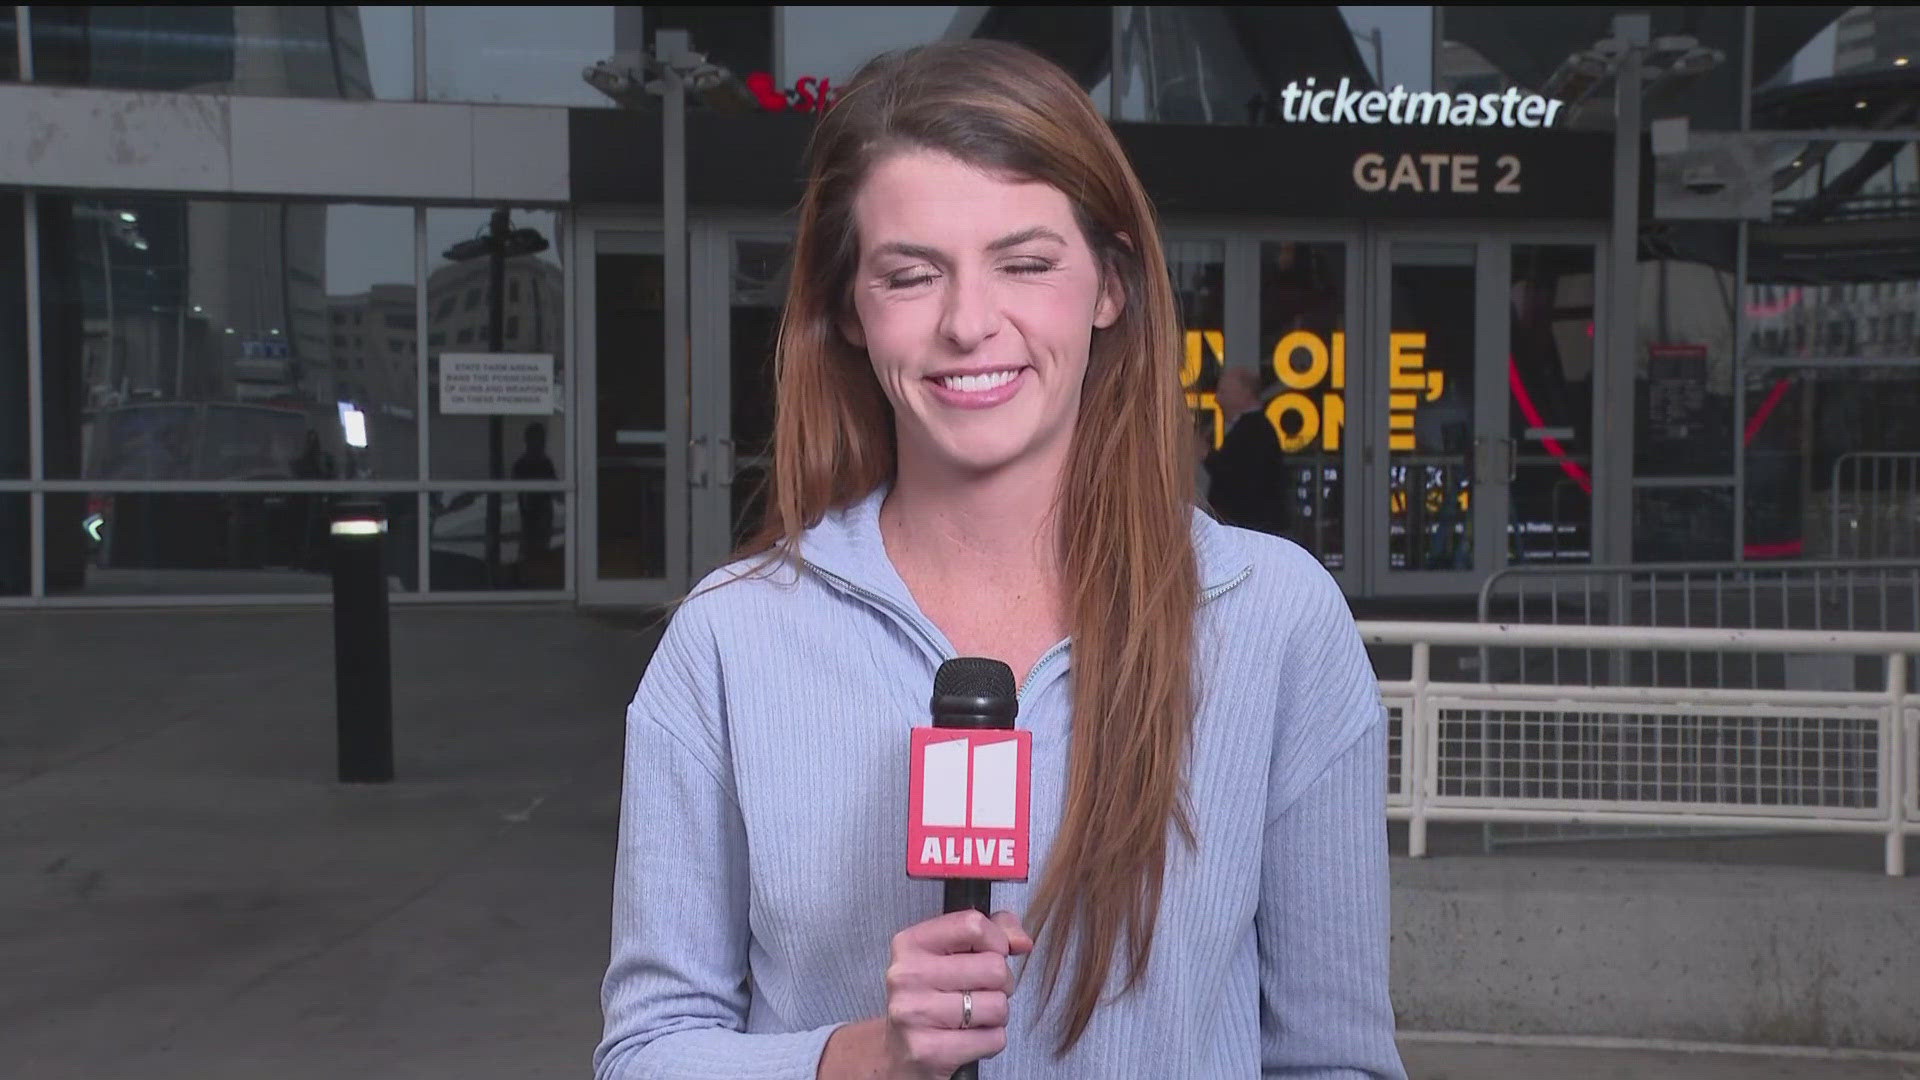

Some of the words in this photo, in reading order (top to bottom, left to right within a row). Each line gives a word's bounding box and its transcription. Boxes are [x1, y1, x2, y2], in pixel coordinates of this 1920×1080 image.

[1281, 77, 1563, 128] ticketmaster
[1352, 153, 1479, 193] GATE
[1494, 154, 1521, 193] 2
[922, 737, 1018, 829] 11
[920, 836, 1016, 867] ALIVE
